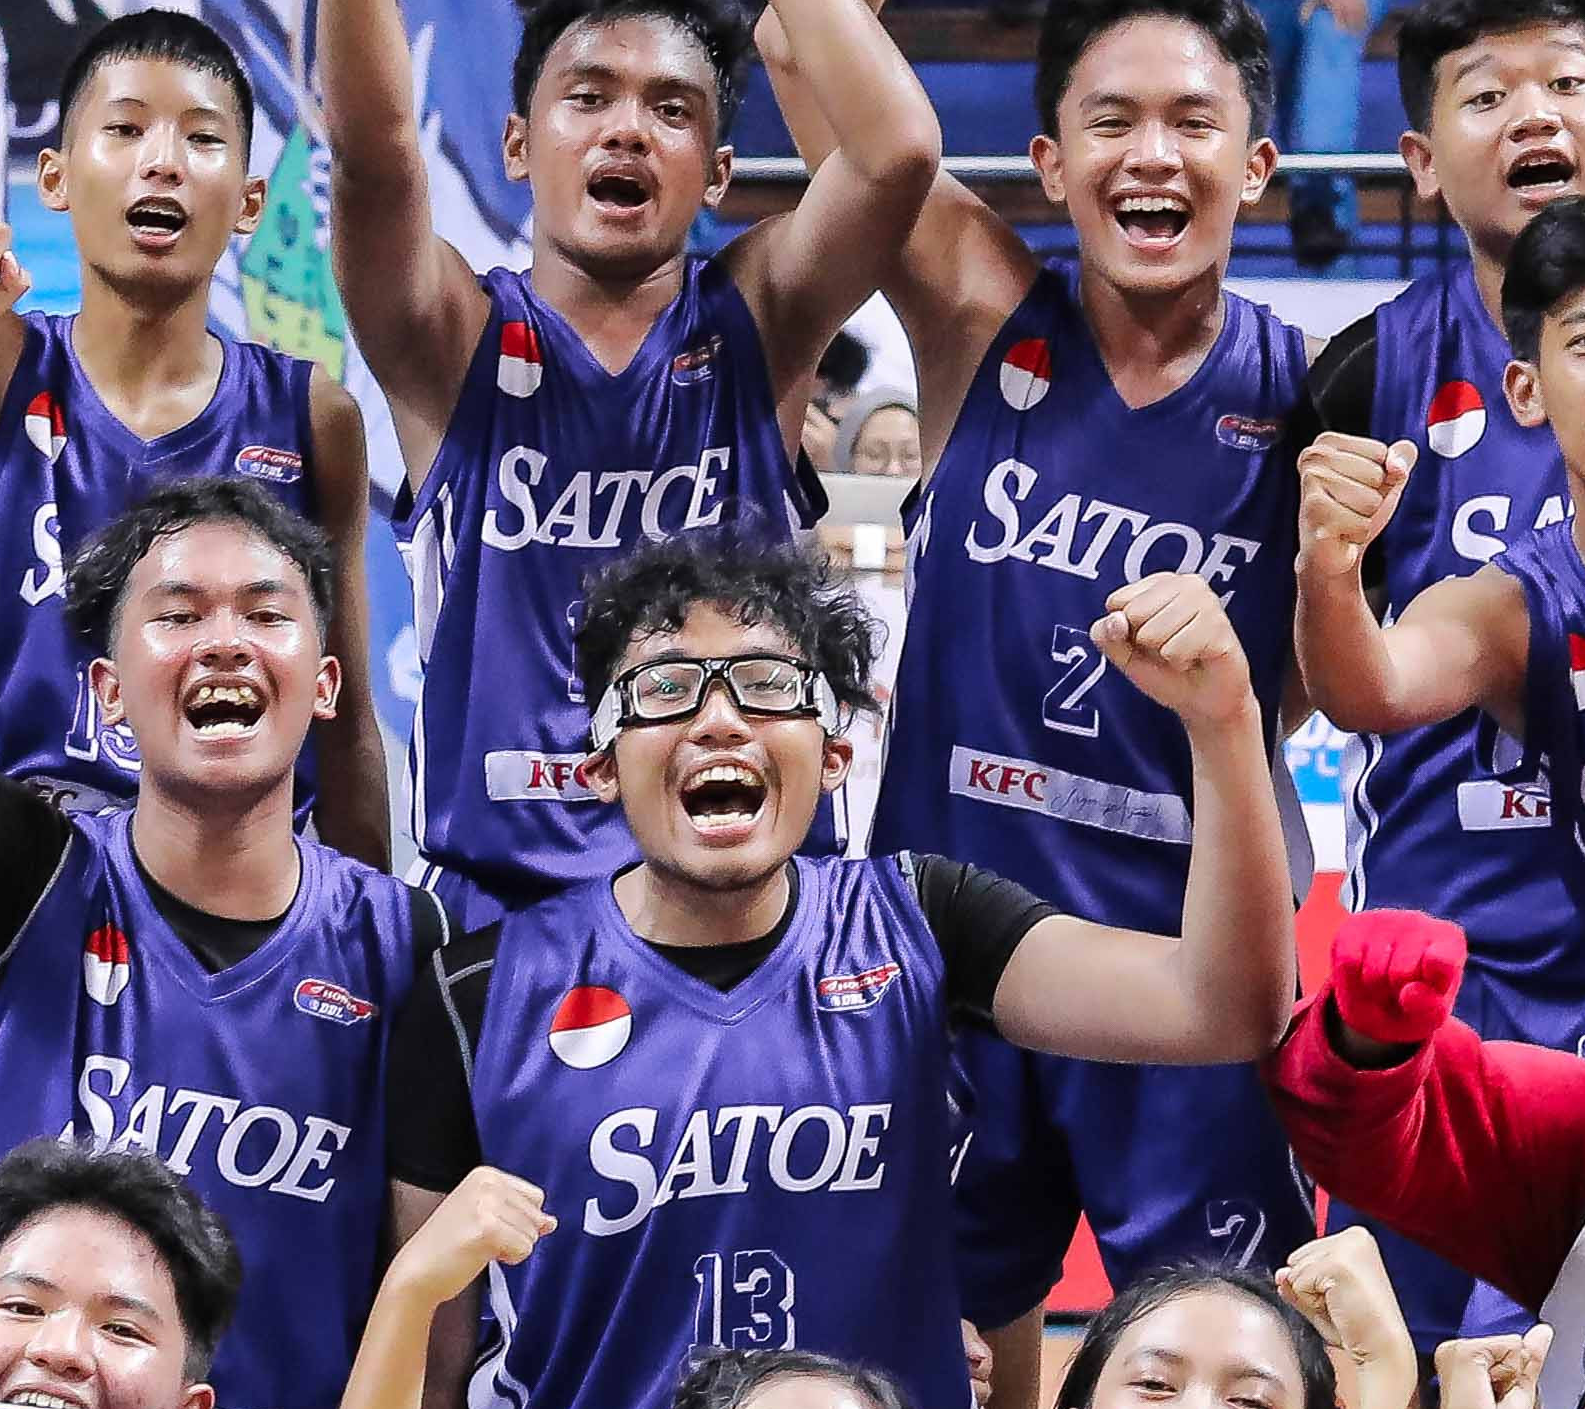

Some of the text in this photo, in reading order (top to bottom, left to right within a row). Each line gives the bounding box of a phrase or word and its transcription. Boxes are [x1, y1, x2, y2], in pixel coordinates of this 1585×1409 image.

[963, 458, 1263, 613] SATOE
[1043, 624, 1107, 738] 2
[967, 759, 1048, 803] KFC
[58, 1054, 352, 1203] SATOE
[582, 1102, 894, 1238] SATOE
[688, 1249, 796, 1358] 13
